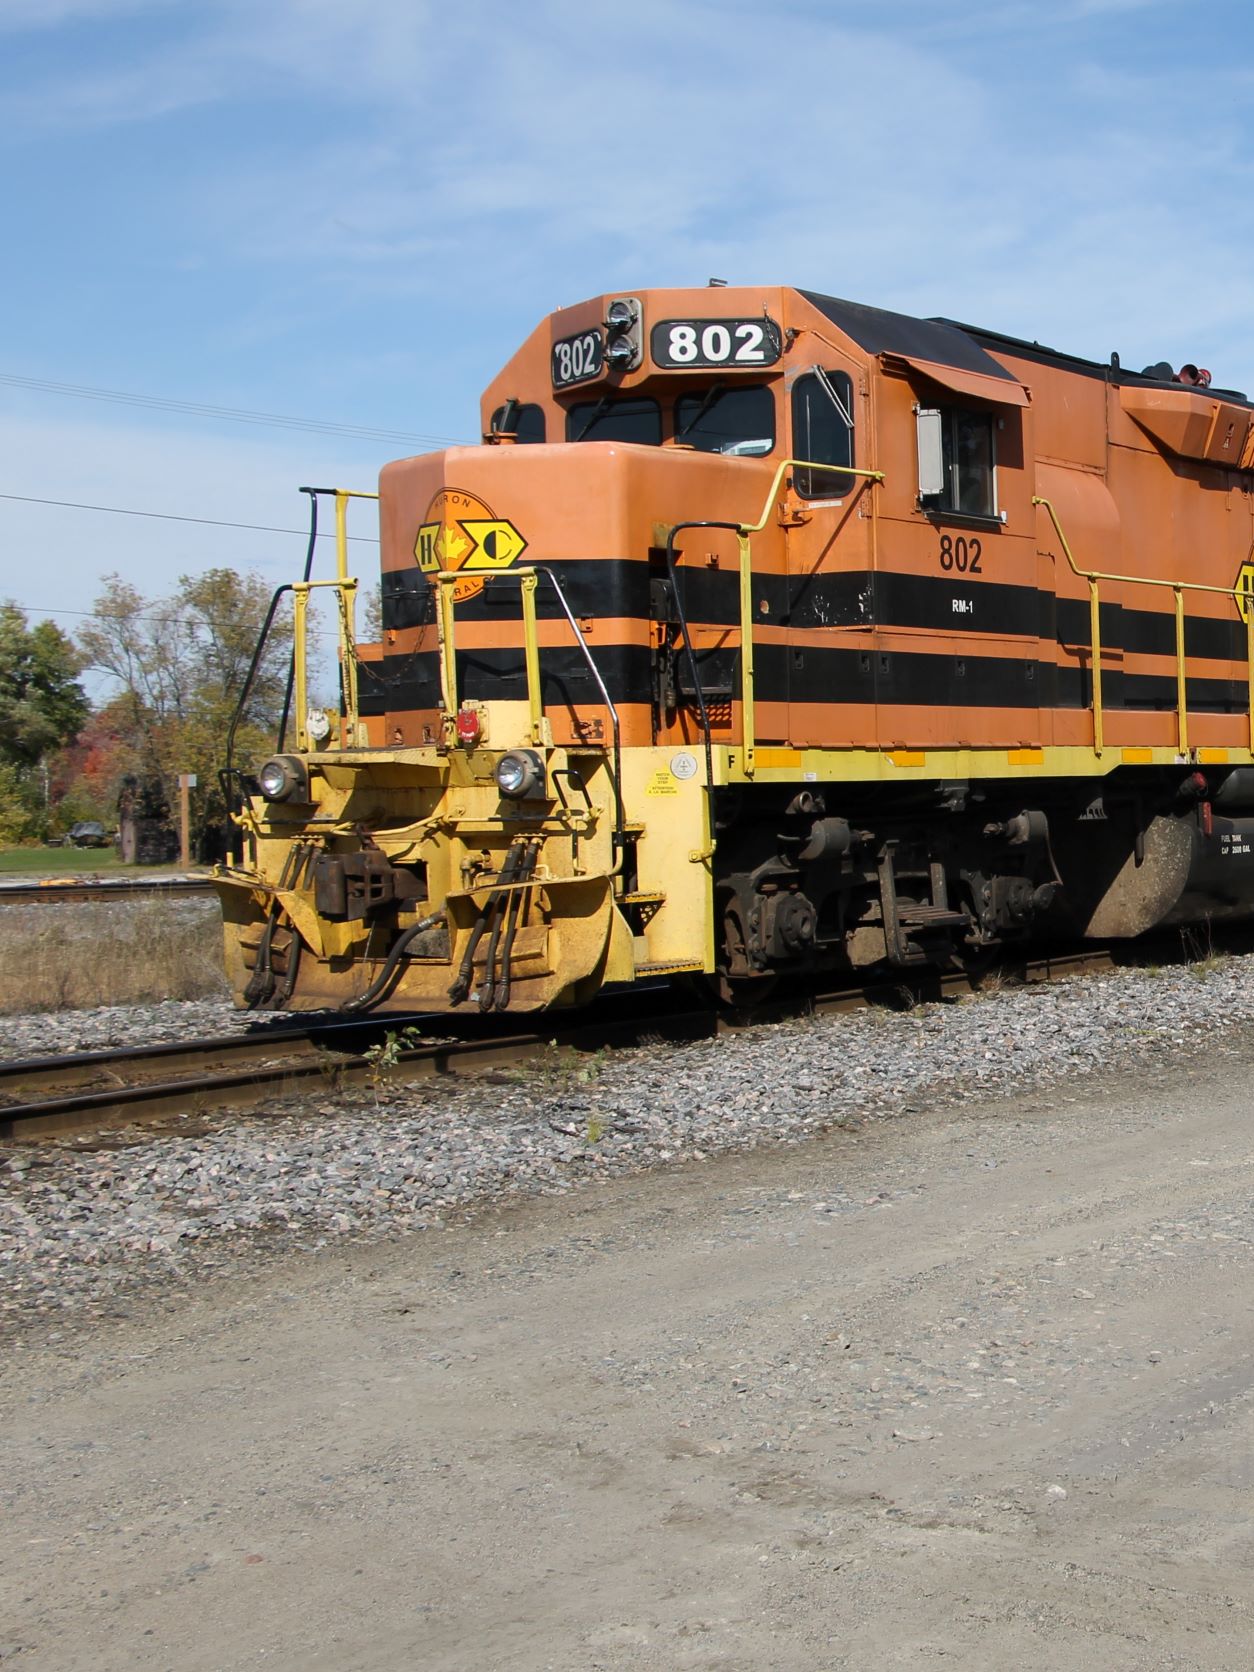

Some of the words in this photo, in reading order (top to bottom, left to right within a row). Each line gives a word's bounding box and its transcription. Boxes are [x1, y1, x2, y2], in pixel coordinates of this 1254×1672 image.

[559, 335, 596, 380] 802
[668, 324, 765, 363] 802
[939, 534, 983, 574] 802
[951, 599, 974, 614] RM-1
[728, 754, 736, 769] F
